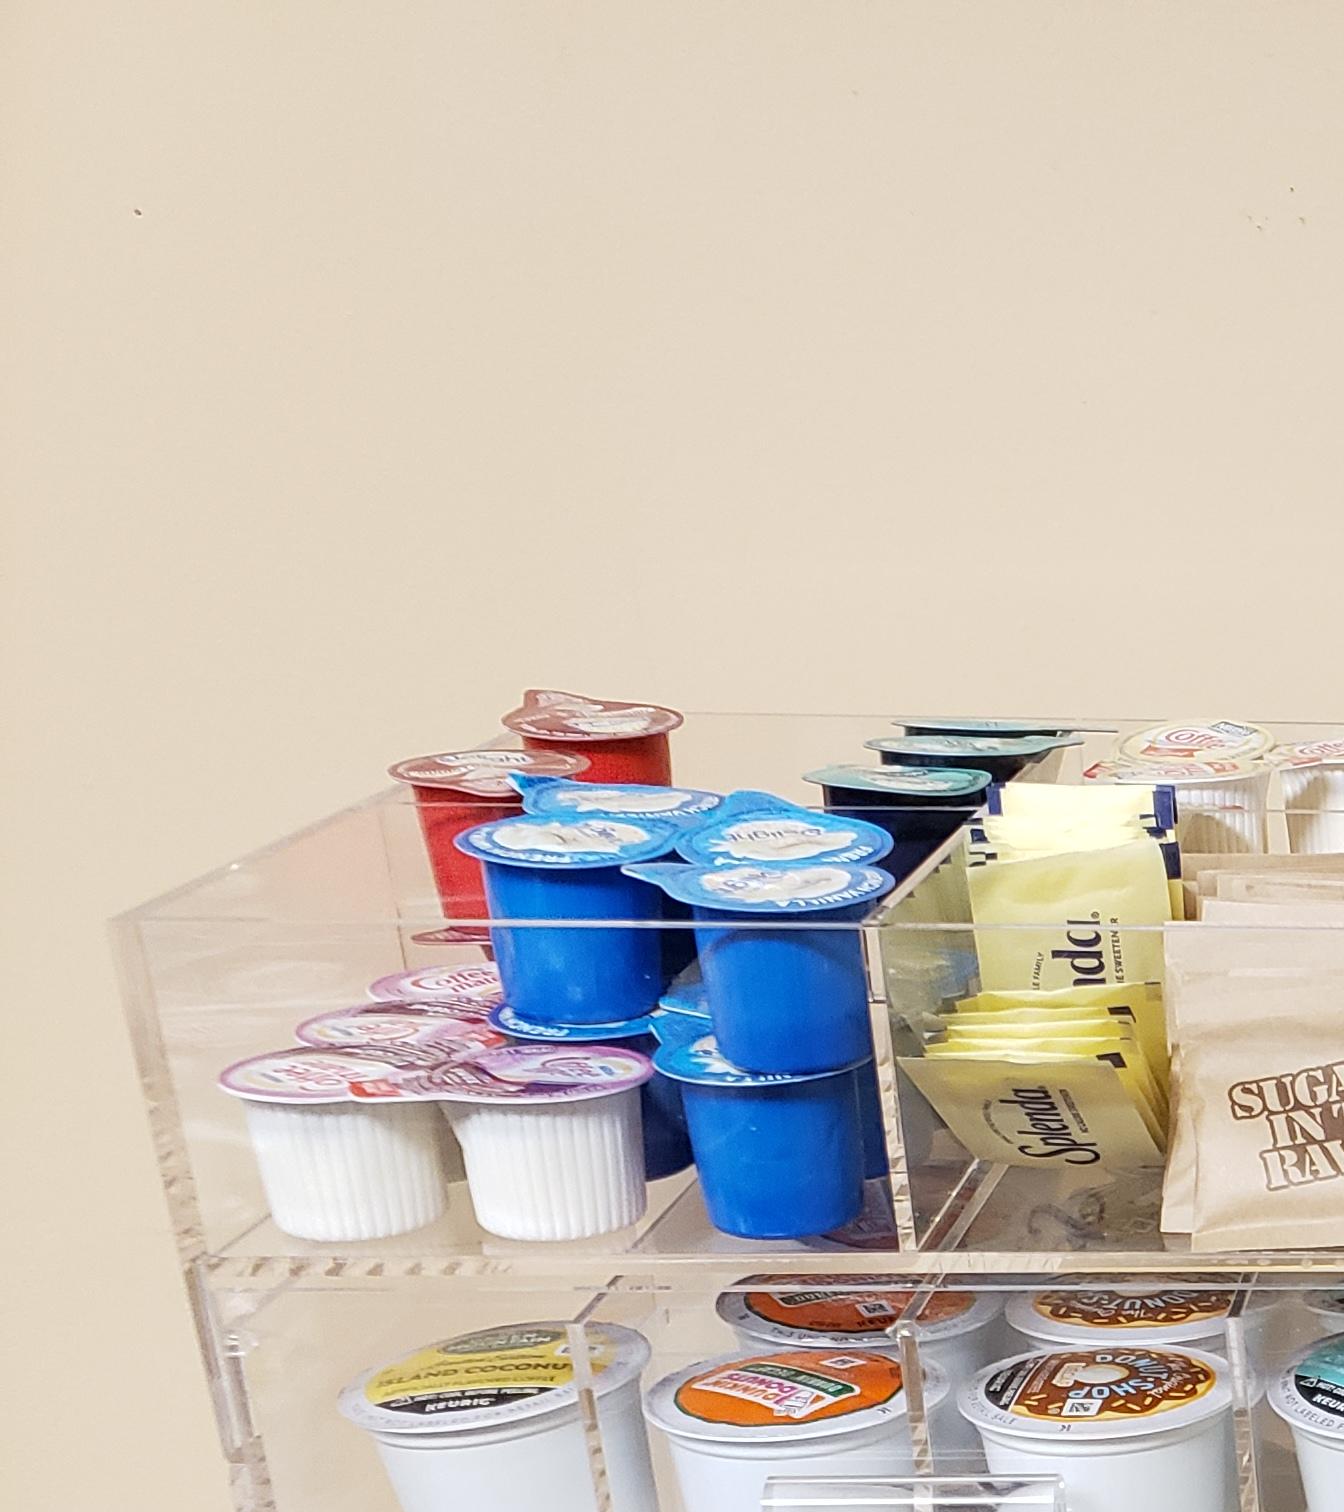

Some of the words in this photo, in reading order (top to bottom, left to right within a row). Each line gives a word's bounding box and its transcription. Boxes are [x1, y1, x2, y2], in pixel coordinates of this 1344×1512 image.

[1110, 917, 1124, 974] SWEETENR
[998, 1087, 1101, 1166] Splenda
[1265, 1109, 1327, 1150] IN
[464, 1362, 574, 1373] COCONU
[1067, 1378, 1155, 1399] SHOP
[424, 1398, 496, 1412] KEURIG
[1295, 1405, 1335, 1427] LABELED
